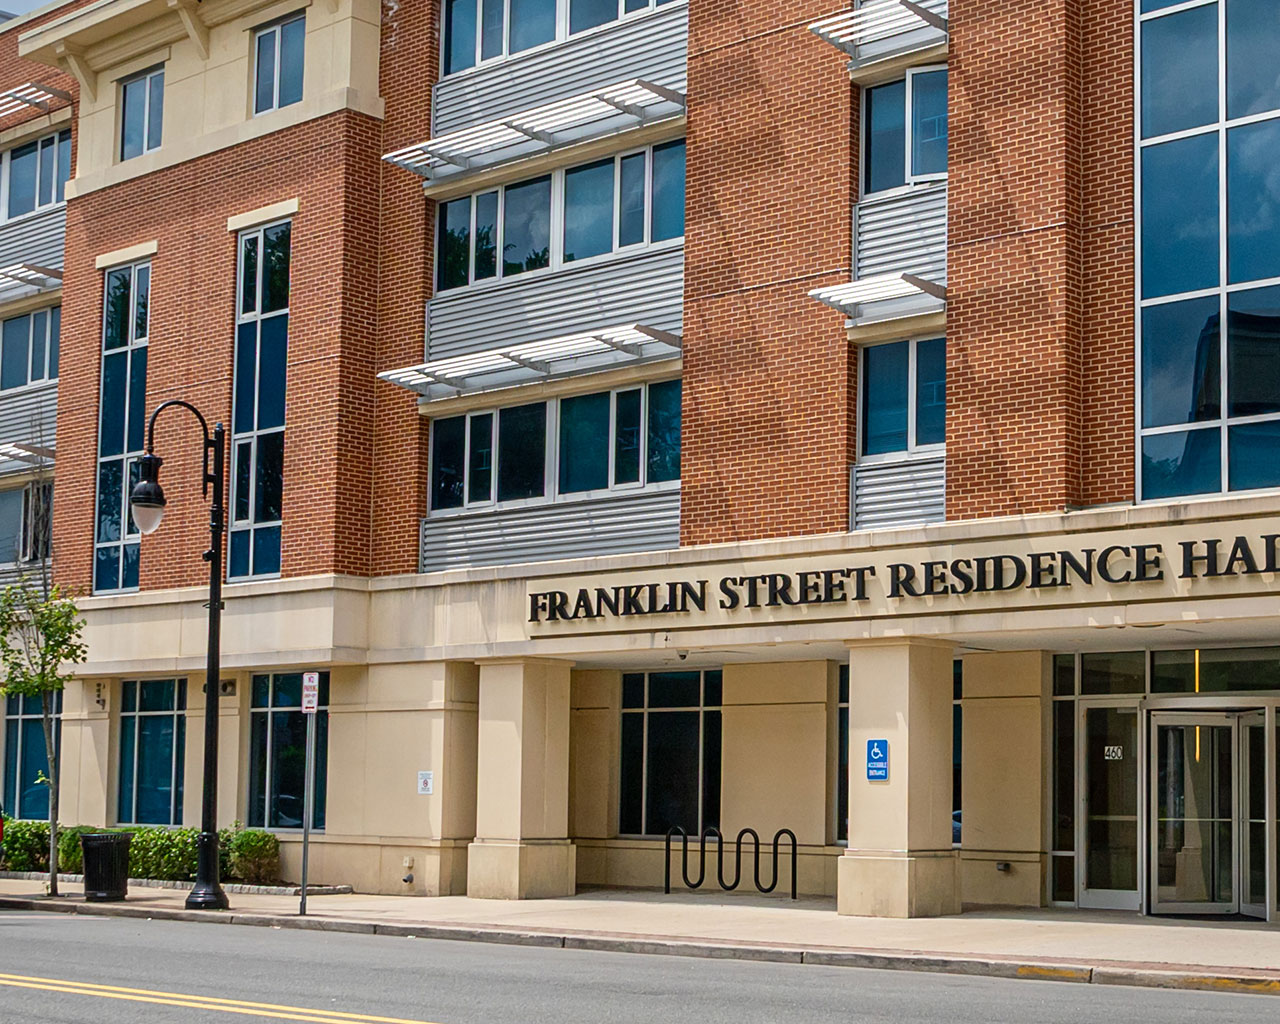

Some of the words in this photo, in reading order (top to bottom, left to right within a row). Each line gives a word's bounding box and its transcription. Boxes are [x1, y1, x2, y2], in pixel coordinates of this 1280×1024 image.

[528, 579, 709, 622] FRANKLIN
[719, 566, 876, 609] STREET
[886, 544, 1164, 598] RESIDENCE
[1105, 747, 1122, 759] 460
